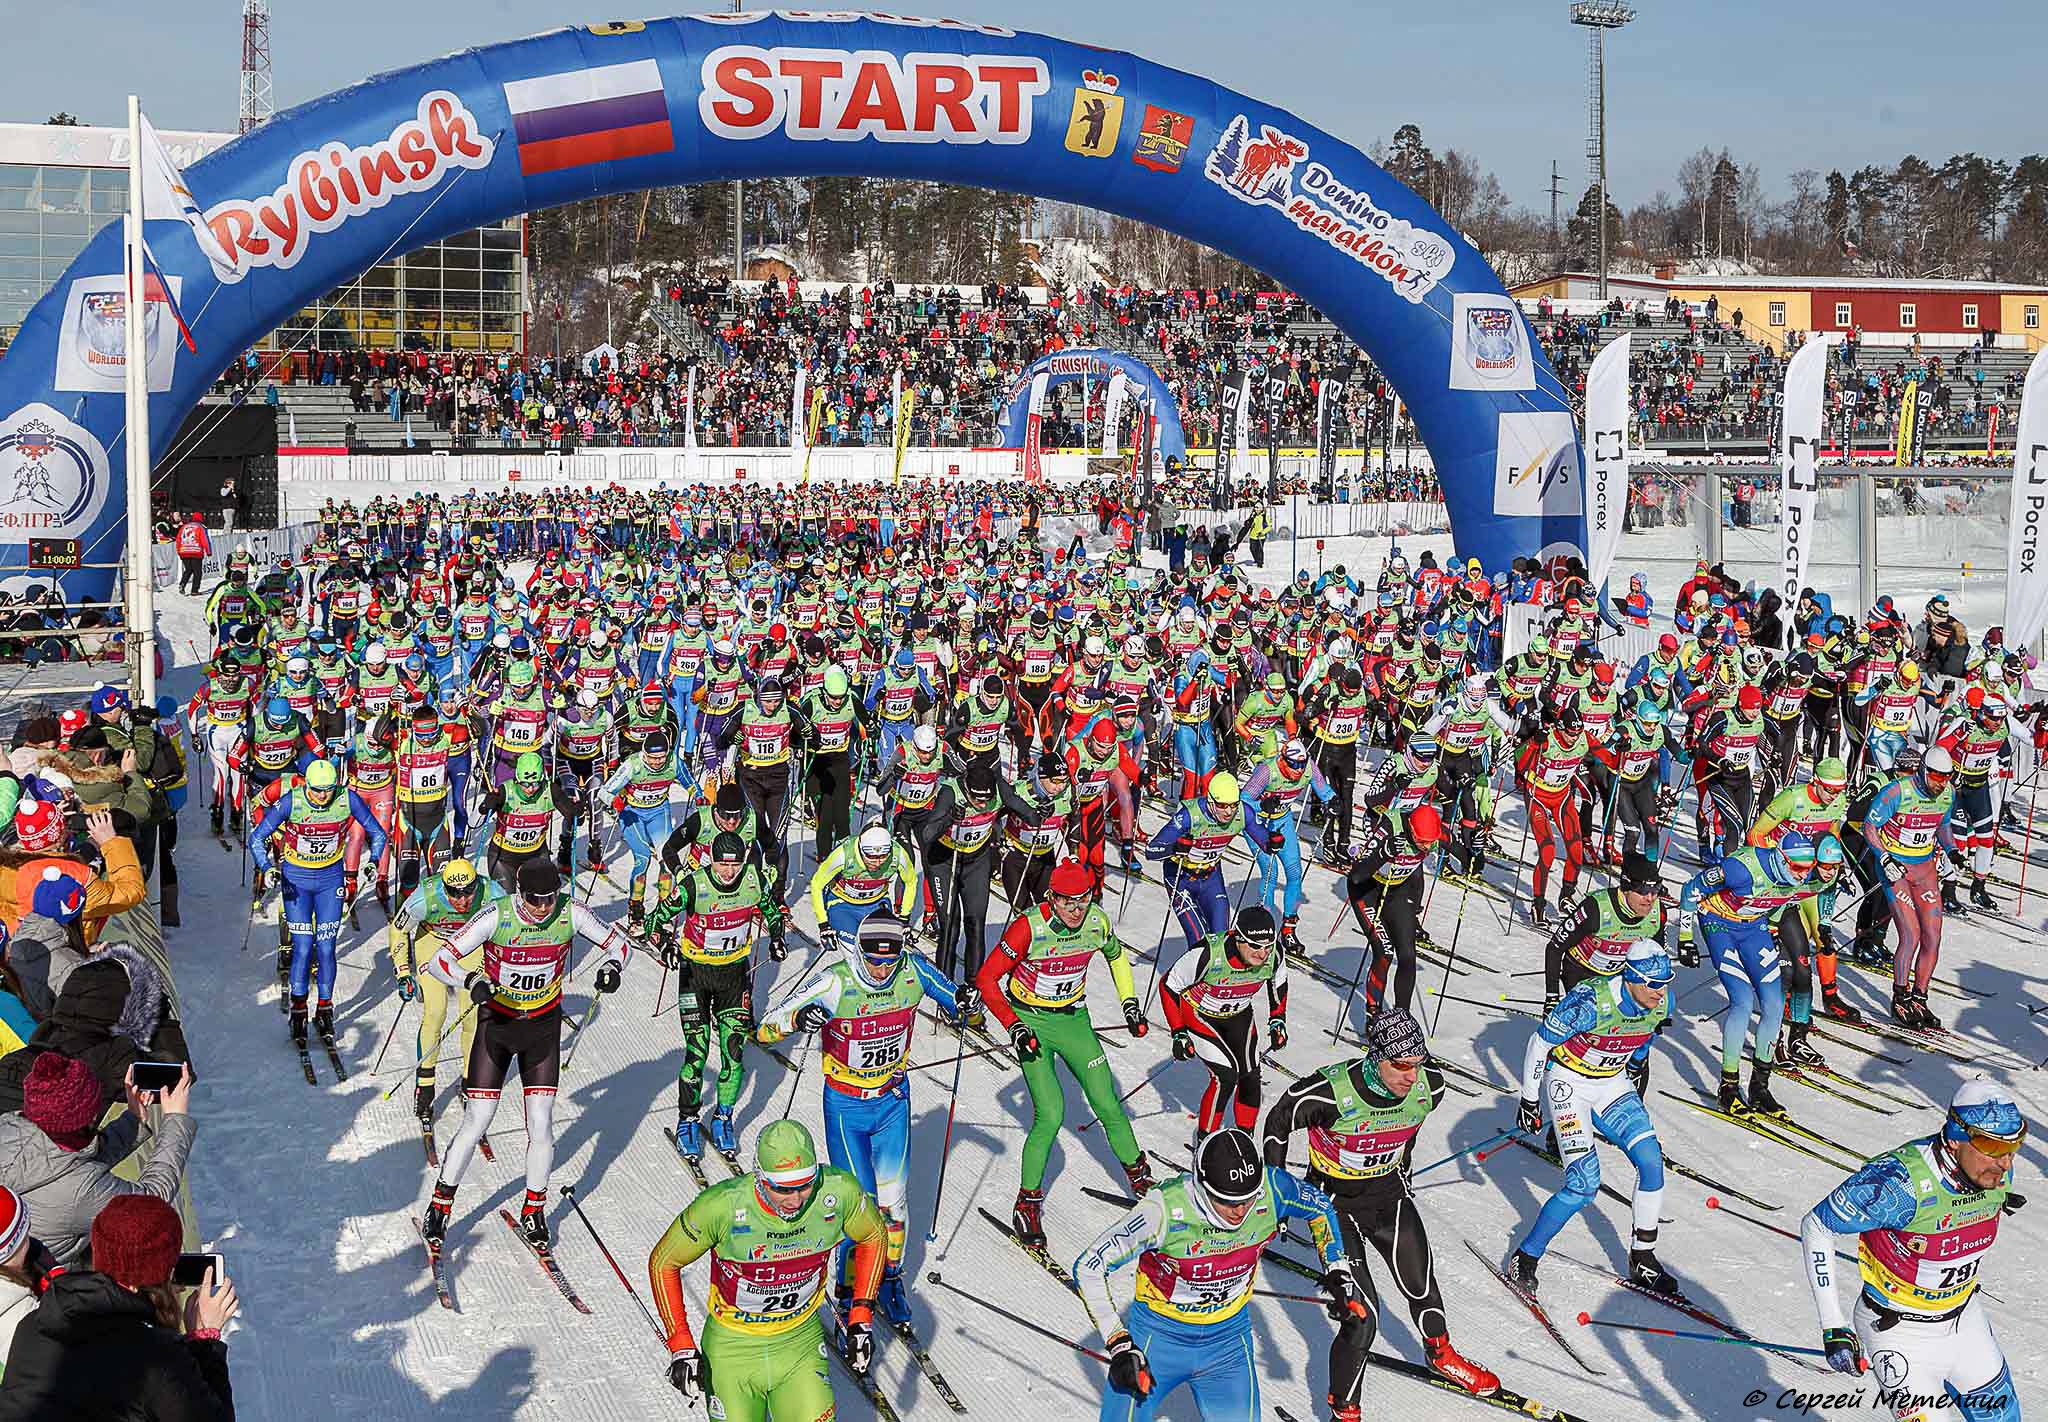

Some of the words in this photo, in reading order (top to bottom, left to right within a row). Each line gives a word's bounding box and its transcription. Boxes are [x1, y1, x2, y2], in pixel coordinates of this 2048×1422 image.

[711, 56, 1038, 133] START
[208, 96, 483, 263] Rybinsk
[1305, 166, 1389, 231] Demino
[1288, 198, 1408, 283] marathon
[1411, 240, 1446, 268] ski
[1051, 356, 1091, 375] FINISH
[1475, 356, 1516, 370] WORLDLOPPET
[1029, 422, 1038, 472] ATOMIC
[1508, 465, 1569, 485] FIS
[1595, 470, 1607, 531] Ростех
[2020, 495, 2044, 574] Ростех
[66, 541, 75, 553] 0
[42, 555, 77, 565] 11:00:07
[1786, 505, 1801, 612] Ростех
[203, 561, 220, 575] ostec
[1031, 664, 1046, 674] 186
[374, 702, 387, 712] 93
[1892, 711, 1905, 721] 92
[511, 728, 530, 740] 146
[1335, 724, 1353, 735] 230
[757, 743, 775, 754] 118
[1733, 752, 1750, 763] 195
[1974, 757, 1992, 768] 145
[421, 775, 437, 788] 86
[908, 788, 926, 799] 161
[512, 828, 537, 843] 409
[963, 831, 982, 842] 63
[309, 840, 327, 855] 52
[722, 936, 738, 950] 71
[509, 970, 546, 991] 206
[1053, 981, 1074, 995] 14
[878, 1022, 905, 1033] Rostec
[861, 1047, 900, 1069] 285
[1532, 1059, 1545, 1081] RUS
[1229, 1158, 1256, 1184] DNB
[1834, 1187, 1870, 1223] BST
[1951, 1192, 1987, 1208] RYBINSK
[766, 1225, 806, 1241] RYBINSK
[1962, 1233, 1992, 1251] Rostec
[1215, 1263, 1249, 1277] Rostec
[1812, 1250, 1831, 1288] RUS
[761, 1292, 800, 1313] 28
[1442, 1362, 1476, 1386] alpina
